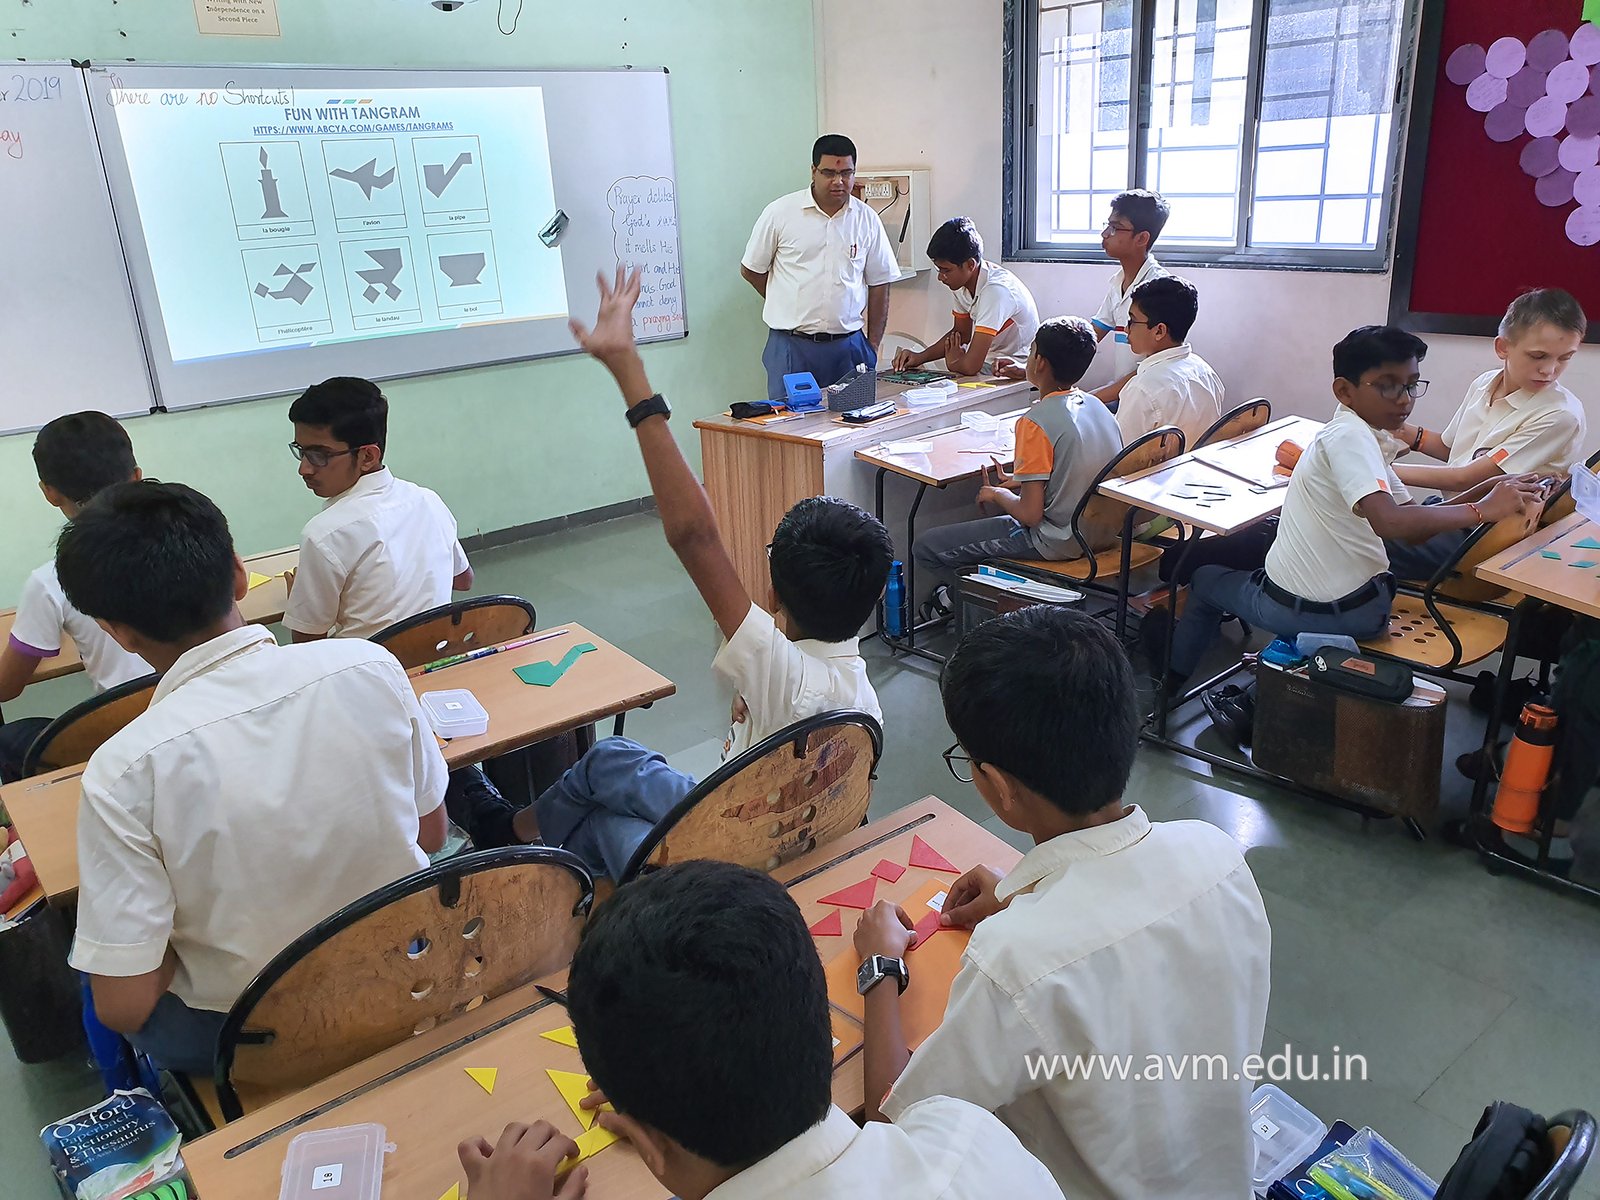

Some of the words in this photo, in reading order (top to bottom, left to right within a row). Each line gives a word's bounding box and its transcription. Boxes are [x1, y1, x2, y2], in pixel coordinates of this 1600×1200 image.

[11, 74, 62, 102] 2019
[100, 73, 150, 107] There
[160, 91, 189, 106] are
[196, 91, 219, 106] no
[223, 80, 295, 107] Shortcuts!
[253, 122, 454, 136] HTTPS://WWW.ABCYA.COM/GAMES/TANGRAMS
[284, 108, 312, 121] FUN
[315, 107, 349, 120] WITH
[351, 106, 421, 120] TANGRAM
[642, 314, 672, 332] praying
[52, 1094, 136, 1139] Oxford
[59, 1111, 134, 1147] Paperback
[63, 1117, 140, 1156] Dictionary
[69, 1155, 81, 1164] &
[82, 1120, 156, 1158] Thesaurus
[113, 1137, 140, 1152] Edition
